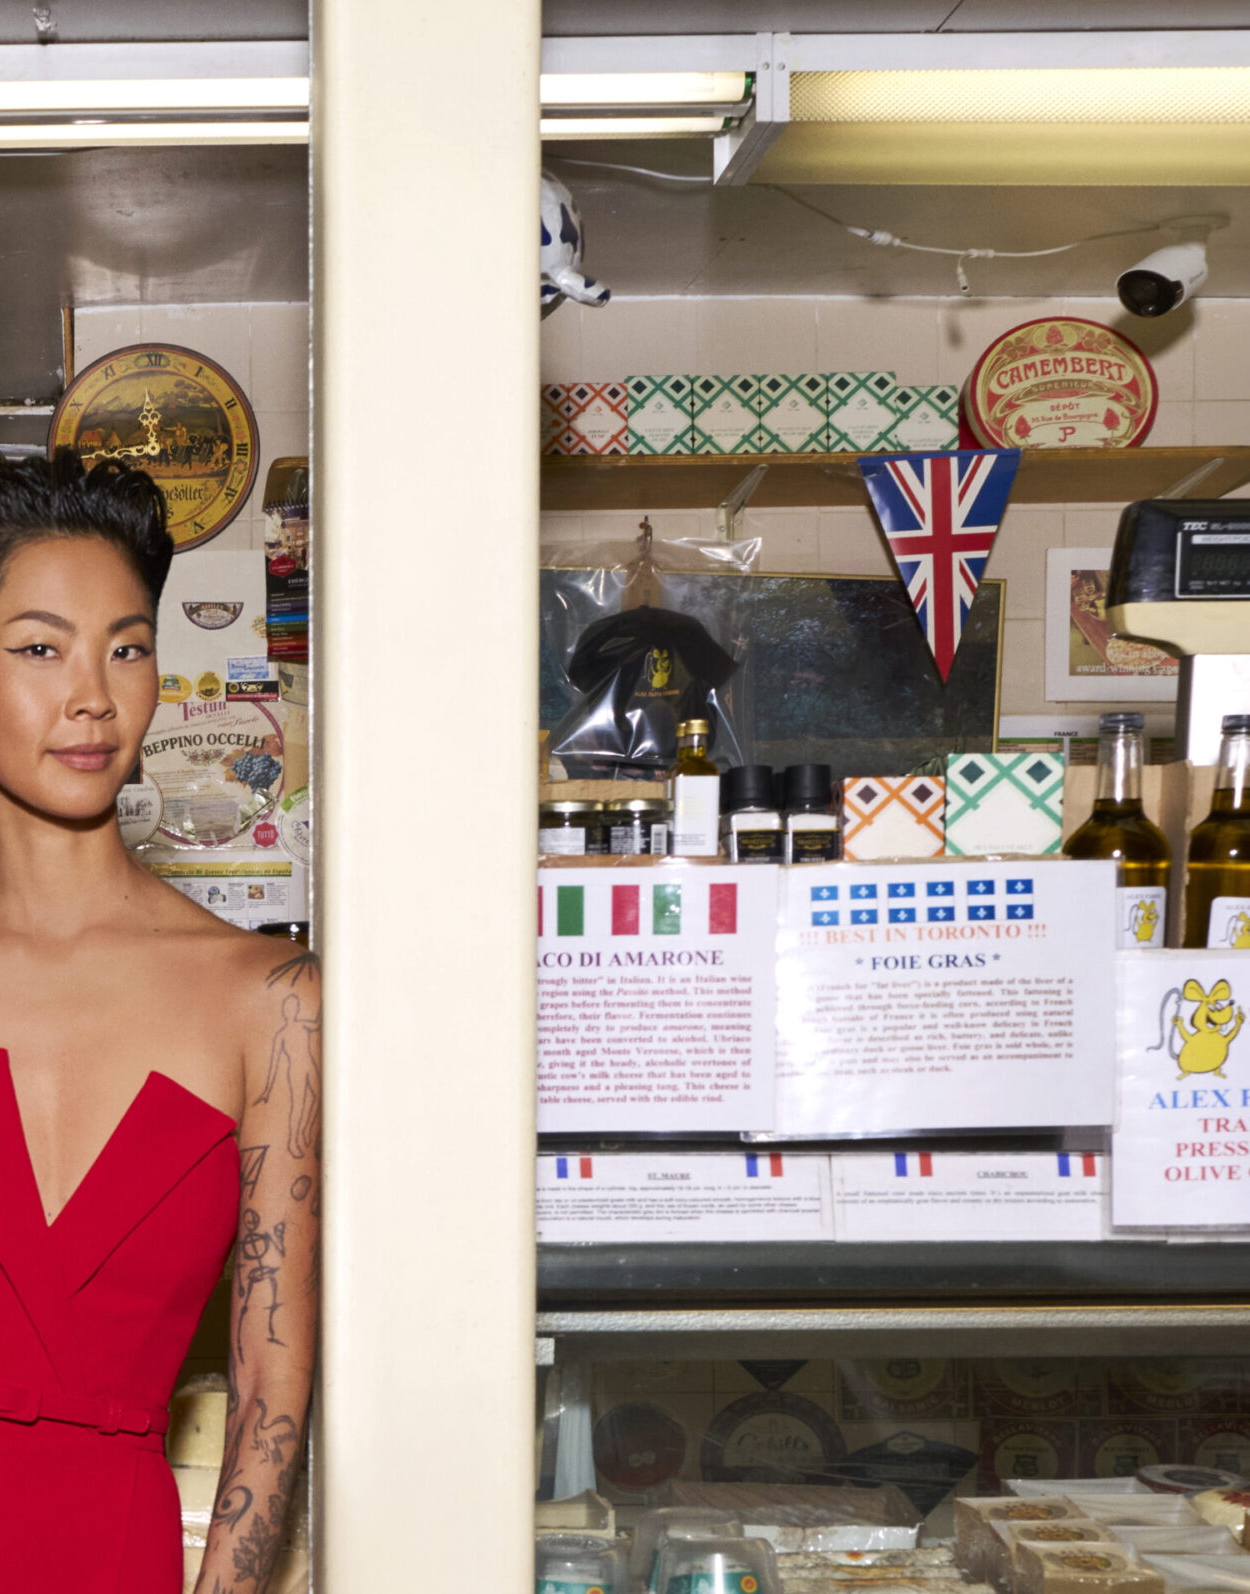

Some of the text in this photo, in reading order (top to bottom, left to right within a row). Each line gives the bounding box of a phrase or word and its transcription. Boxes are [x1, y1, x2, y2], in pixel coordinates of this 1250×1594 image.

[996, 356, 1126, 390] CAMEMBERT
[1182, 522, 1208, 531] TEC
[142, 732, 267, 758] BEPPINO OCCELLI
[826, 929, 878, 945] BEST
[886, 927, 908, 942] IN
[916, 924, 1021, 942] TORONTO
[580, 951, 601, 968] DI
[608, 950, 725, 967] AMARONE
[871, 953, 987, 971] FOIE GRAS
[1148, 1089, 1232, 1109] ALEX
[1164, 1165, 1241, 1181] OLIVE
